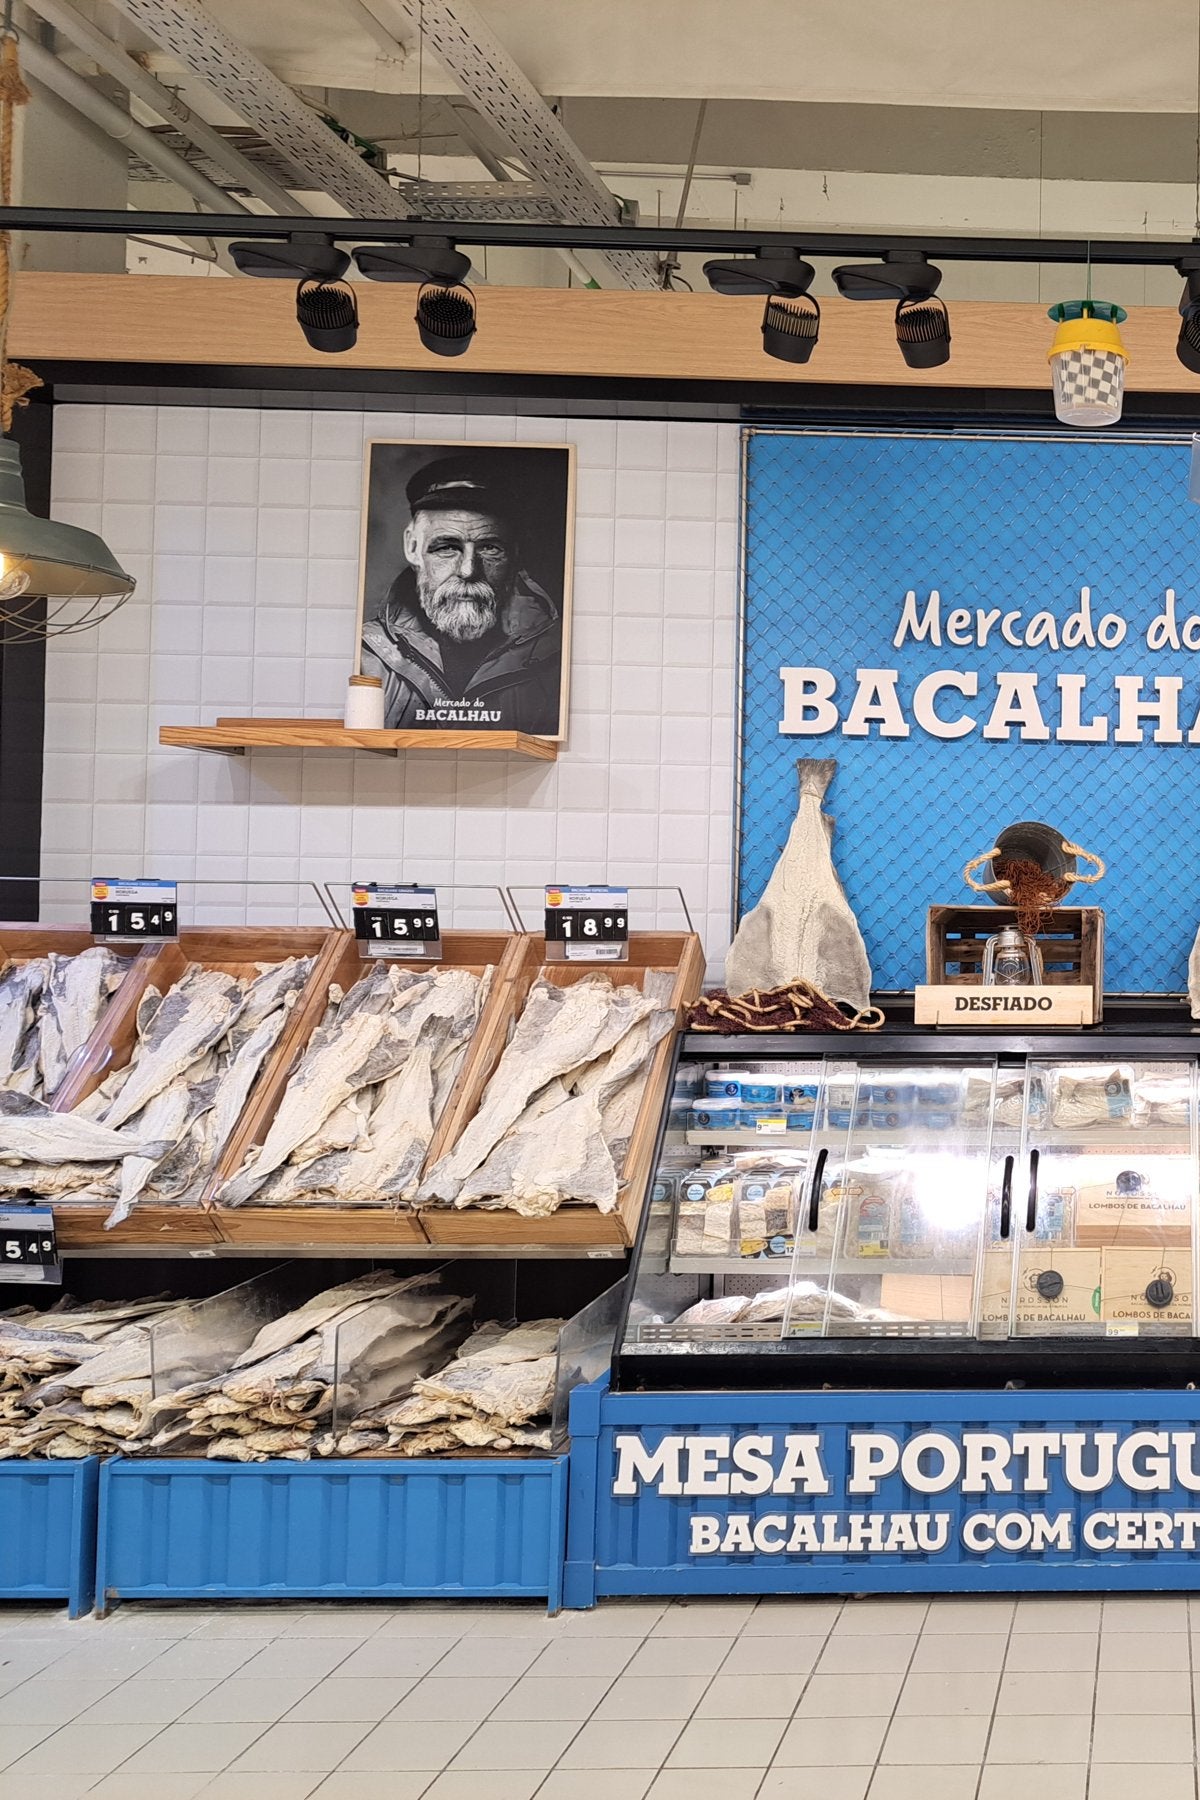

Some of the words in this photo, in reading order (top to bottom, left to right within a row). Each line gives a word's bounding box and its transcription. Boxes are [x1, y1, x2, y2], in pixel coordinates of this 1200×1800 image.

[894, 586, 1127, 651] Mercado
[433, 697, 471, 707] Mercado
[473, 697, 485, 707] do
[415, 709, 502, 722] BACALHAU
[955, 996, 1053, 1011] DESFIADO
[982, 1313, 1021, 1322] LOMBS
[1023, 1313, 1036, 1321] DE
[1037, 1313, 1086, 1322] BACALHAU
[1113, 1310, 1151, 1319] LOMBOS
[1153, 1311, 1165, 1319] DE
[611, 1433, 831, 1496] MESA
[690, 1513, 950, 1555] BACALHAU
[963, 1513, 1072, 1552] COM
